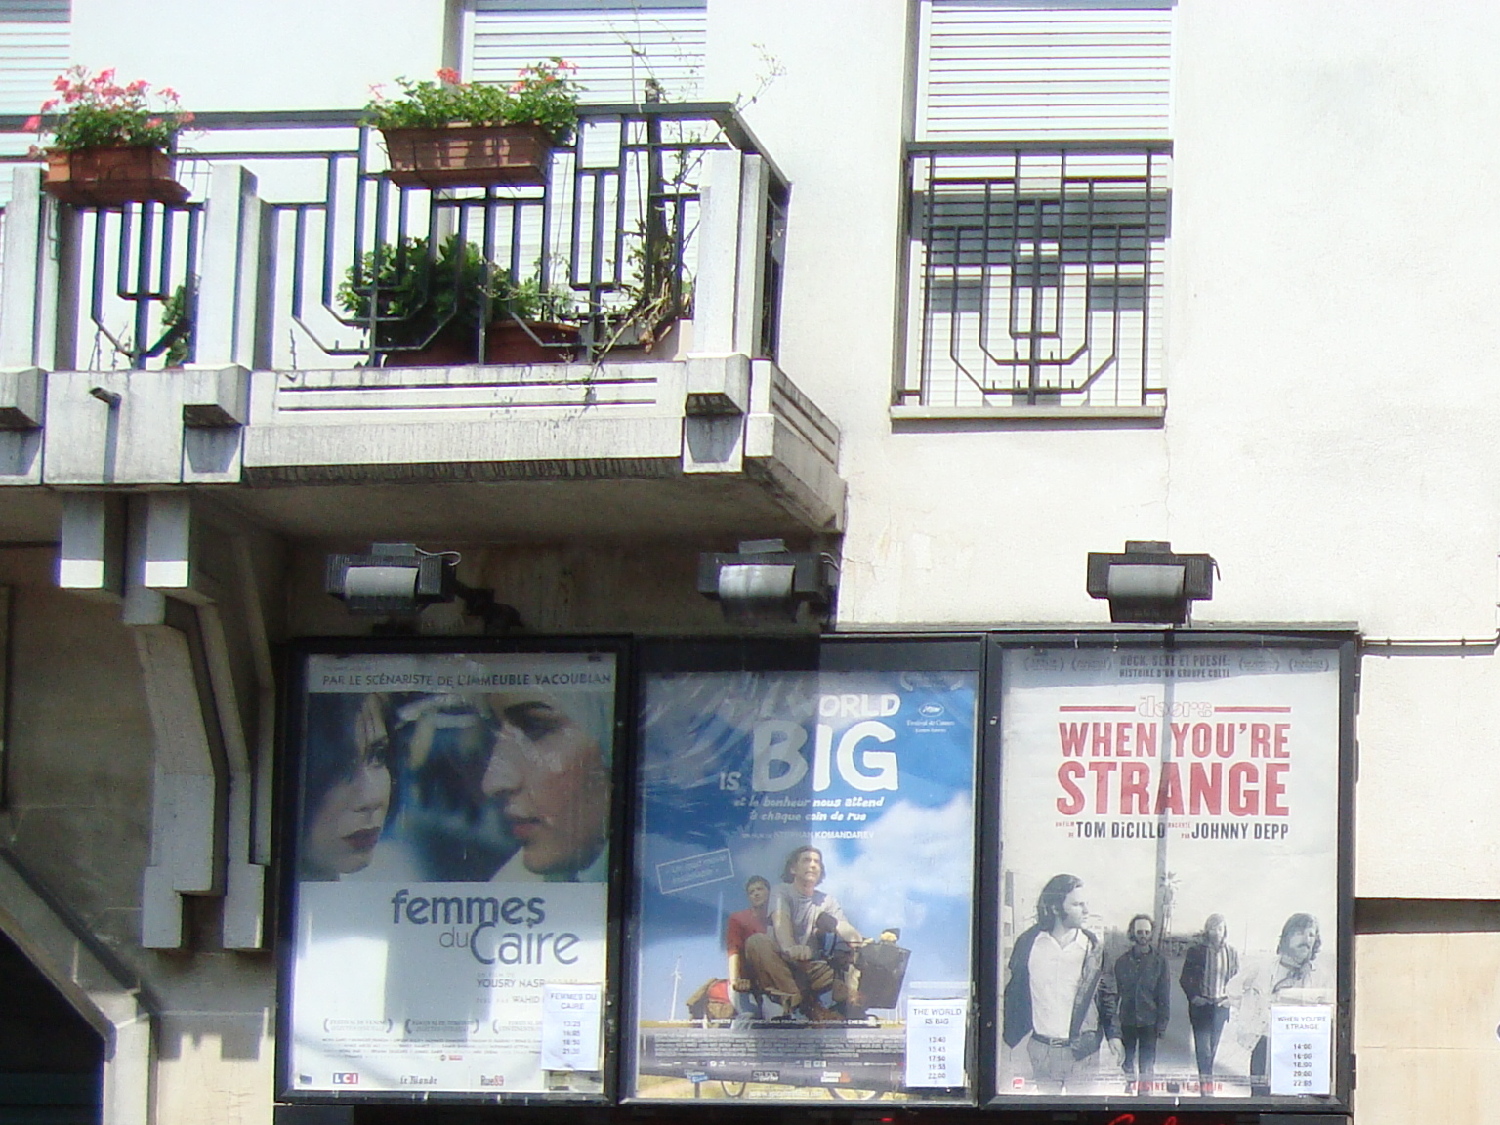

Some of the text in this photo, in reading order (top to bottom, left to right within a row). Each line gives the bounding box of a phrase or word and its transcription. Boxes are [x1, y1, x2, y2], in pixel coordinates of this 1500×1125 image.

[322, 675, 345, 686] PAR
[350, 674, 361, 686] LE
[366, 671, 433, 686] SCÉNARISTE
[437, 675, 453, 686] DE
[535, 672, 612, 685] YACOUBIAN
[1119, 669, 1154, 678] HISTOIRE
[1177, 669, 1205, 678] GROUPE
[1059, 722, 1291, 758] WHEN YOU'RE
[719, 720, 899, 792] IS BIG
[1056, 761, 1290, 816] STRANGE
[763, 796, 811, 807] bonheur
[812, 799, 842, 807] nous
[845, 797, 885, 807] attend
[761, 811, 801, 823] chaque
[805, 811, 827, 821] coin
[830, 811, 843, 821] de
[847, 812, 867, 821] rue
[1076, 822, 1105, 838] TOM
[1191, 823, 1289, 839] JOHNNY DEPP
[391, 889, 546, 927] femmes
[439, 922, 580, 965] du Caire
[477, 978, 515, 988] YOUSRY
[932, 1008, 962, 1016] WORLD
